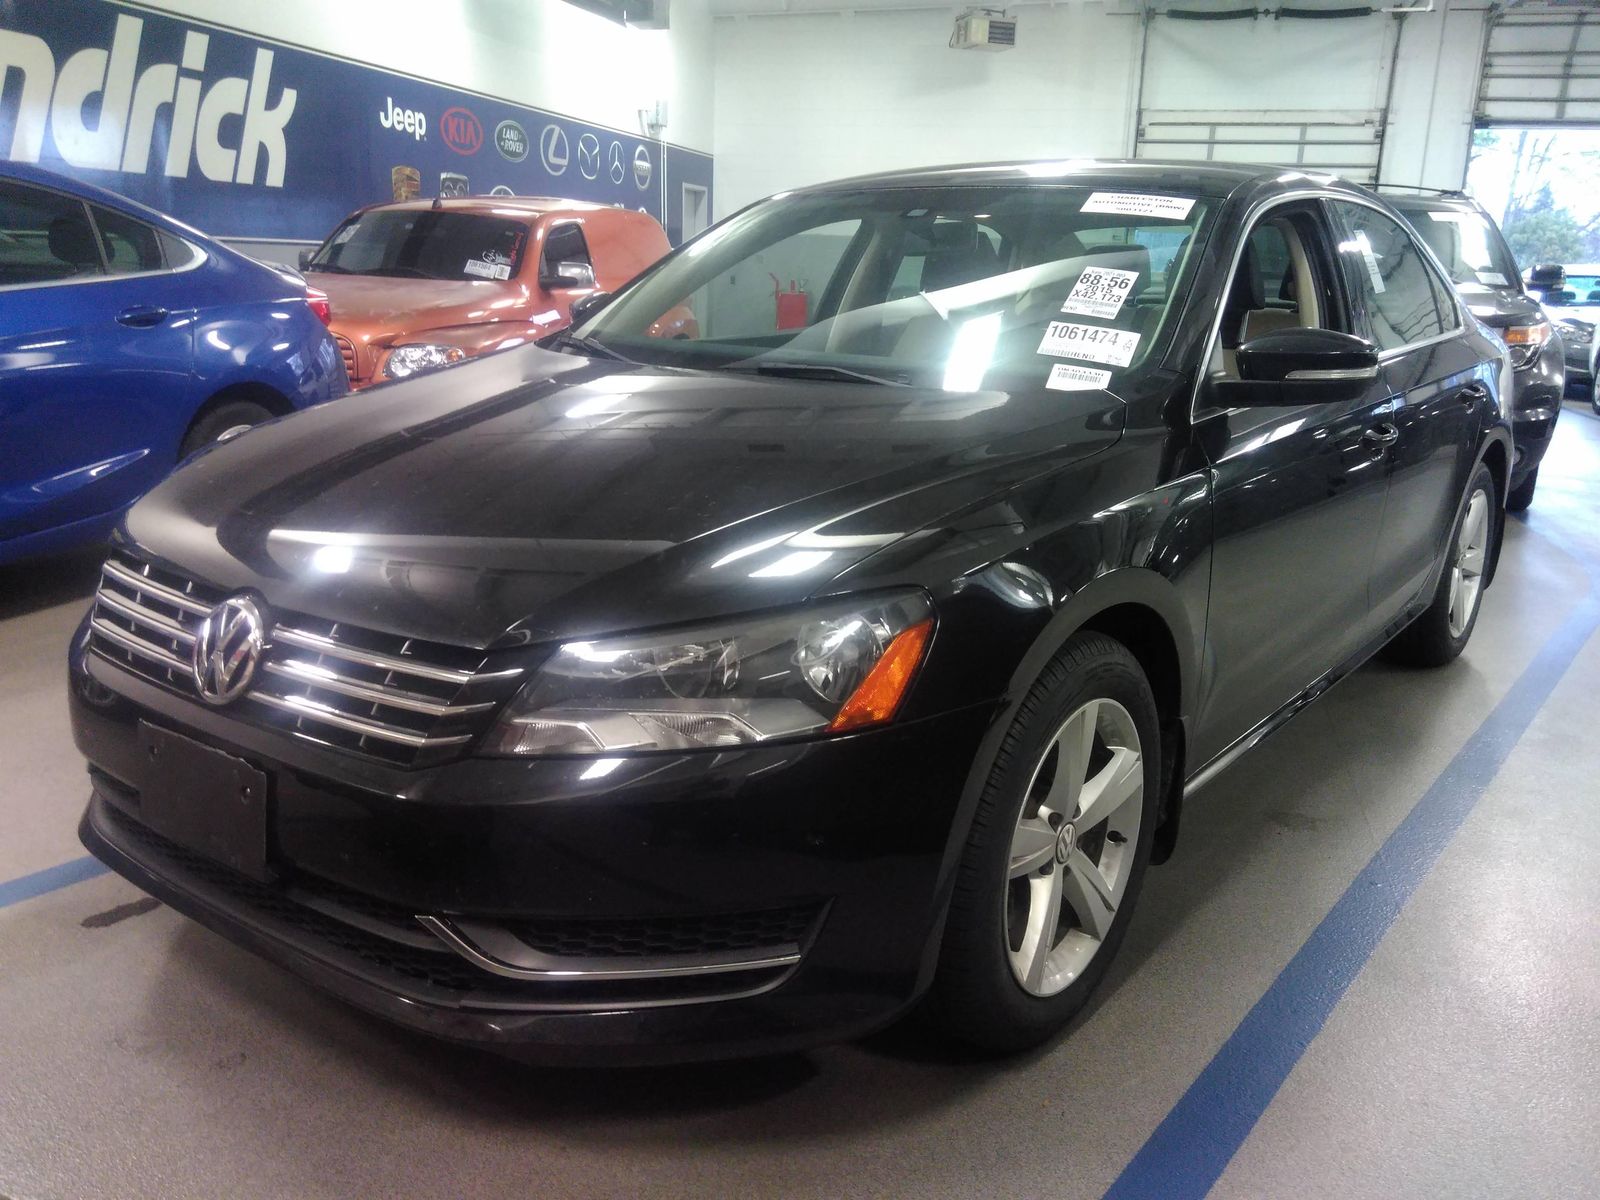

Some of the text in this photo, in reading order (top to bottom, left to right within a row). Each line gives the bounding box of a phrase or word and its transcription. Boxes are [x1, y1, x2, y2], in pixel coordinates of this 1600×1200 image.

[380, 97, 427, 141] Jeep
[448, 116, 478, 147] KIA
[502, 127, 519, 141] LAND
[503, 138, 524, 154] ROVER
[1092, 199, 1152, 207] AUTOMOTIVE
[1079, 273, 1131, 290] 88:56
[1084, 284, 1114, 295] 2015
[1051, 324, 1120, 346] 1061474
